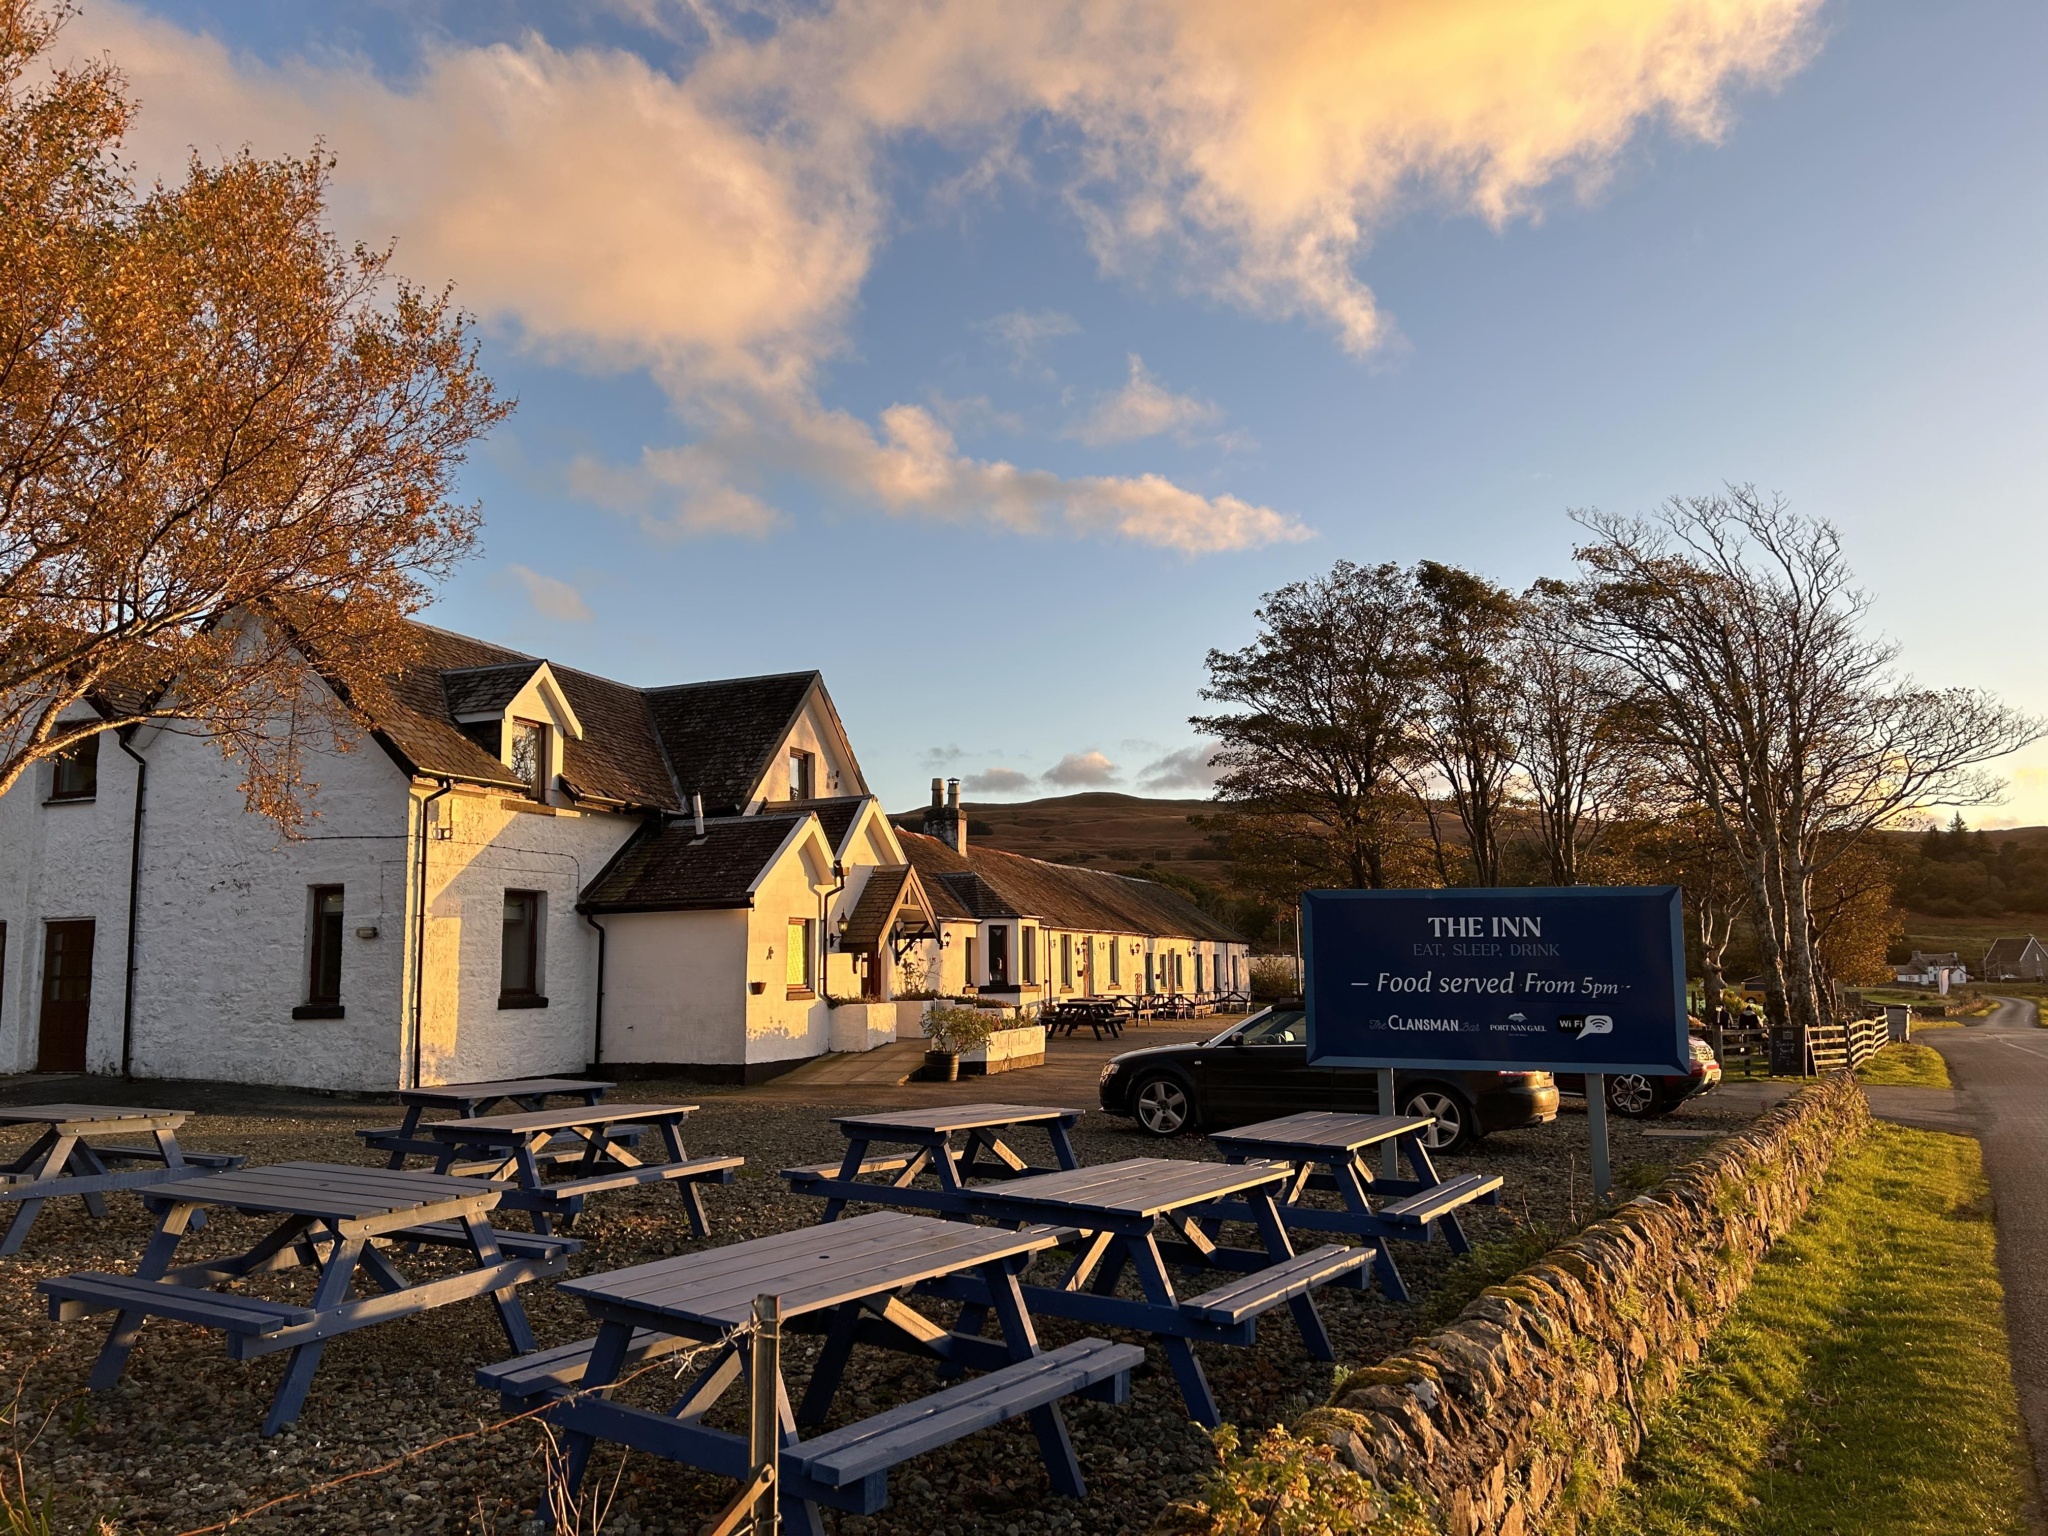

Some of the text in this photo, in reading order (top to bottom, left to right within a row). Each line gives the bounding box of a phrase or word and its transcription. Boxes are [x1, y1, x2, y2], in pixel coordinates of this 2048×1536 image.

[1427, 916, 1542, 938] THE INN
[1413, 943, 1446, 957] EAT,
[1510, 943, 1560, 957] DRINK
[1377, 970, 1619, 999] Food served From 5pm
[1369, 1019, 1387, 1031] The
[1388, 1014, 1459, 1032] CLANSMAN
[1489, 1024, 1547, 1032] PORT NAN GAEL
